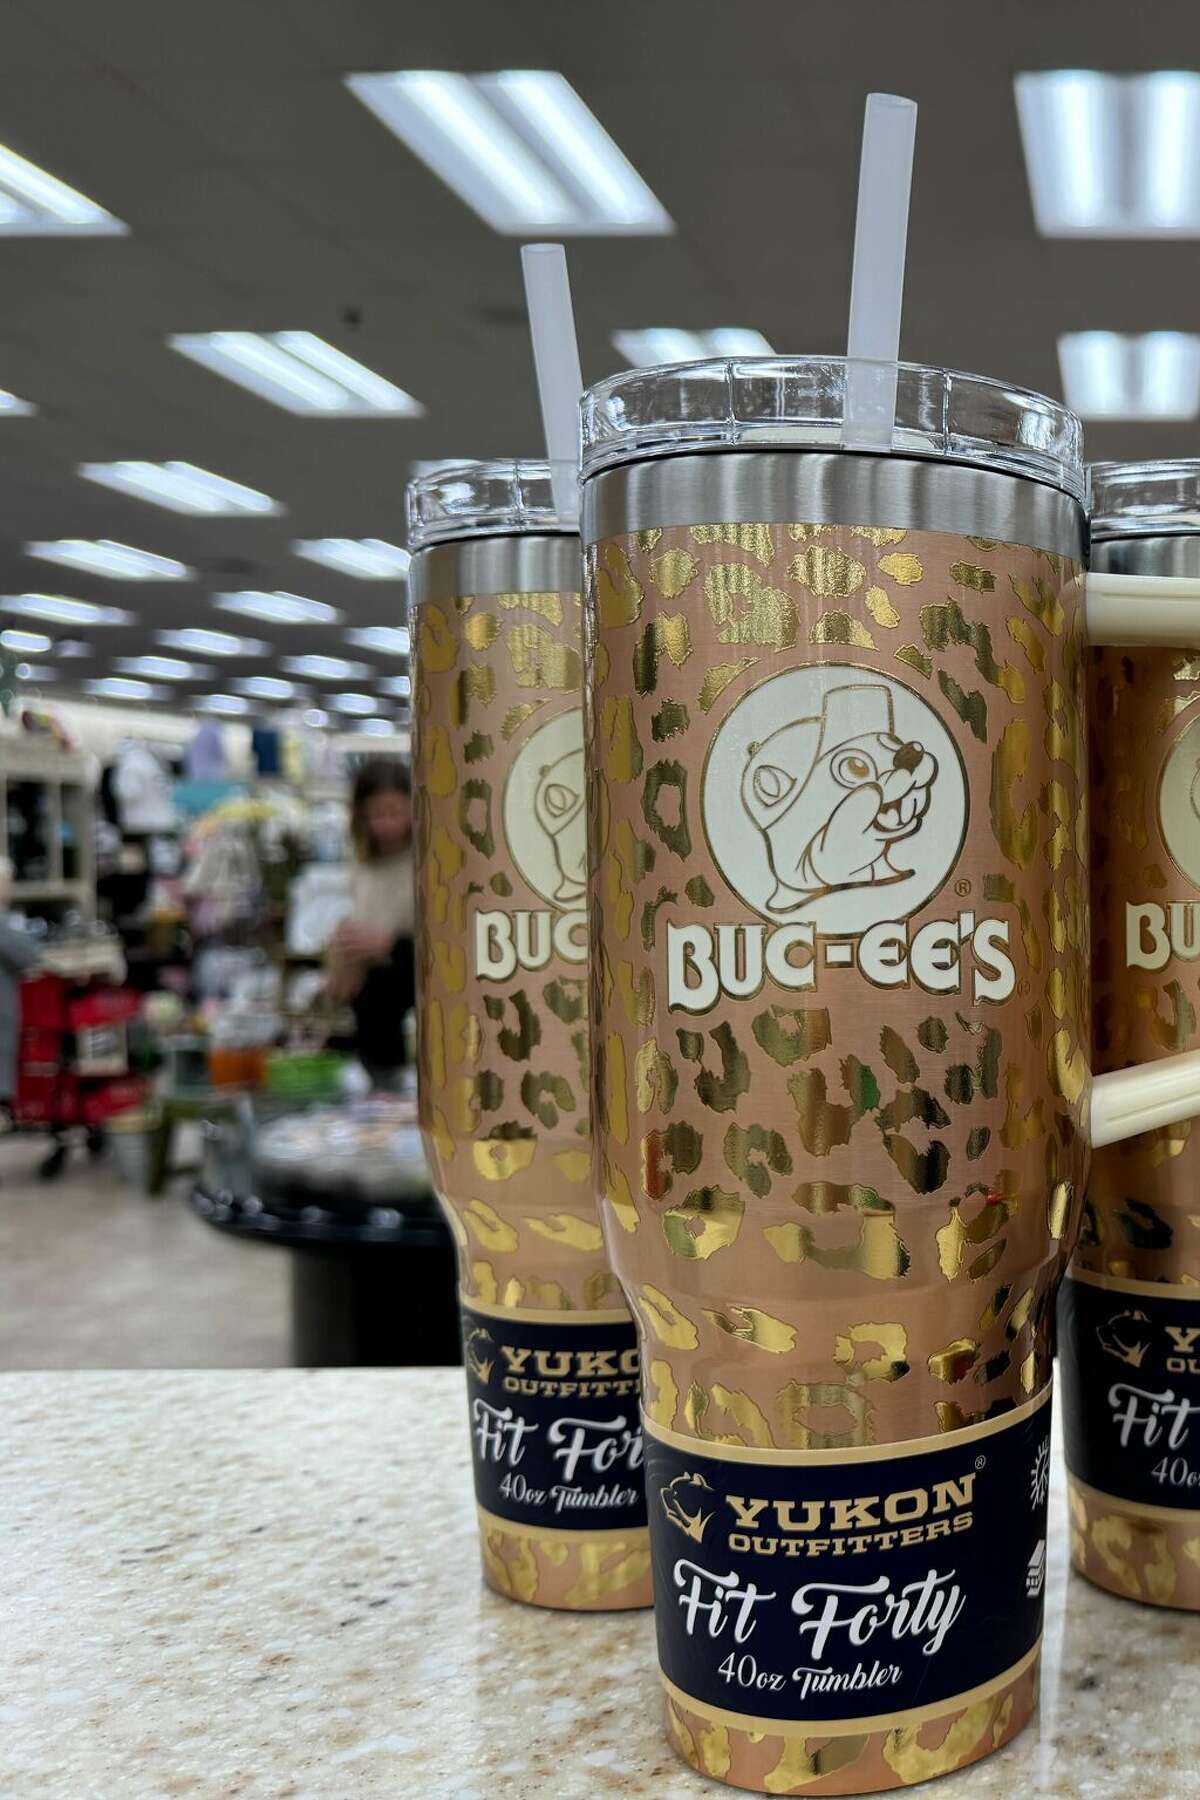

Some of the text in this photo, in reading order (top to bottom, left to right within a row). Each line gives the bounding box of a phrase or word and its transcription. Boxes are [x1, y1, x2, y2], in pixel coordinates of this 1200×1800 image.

[667, 911, 1016, 1015] BUC-EE'S
[504, 1377, 641, 1397] OUTFITT
[474, 1398, 539, 1467] Fit
[501, 1472, 640, 1514] 40oz Tumbler
[726, 1473, 978, 1530] YUKON
[729, 1512, 974, 1556] OUTFITTERS
[673, 1559, 967, 1660] Fit Forty
[718, 1653, 903, 1699] 40oz Tumbler
